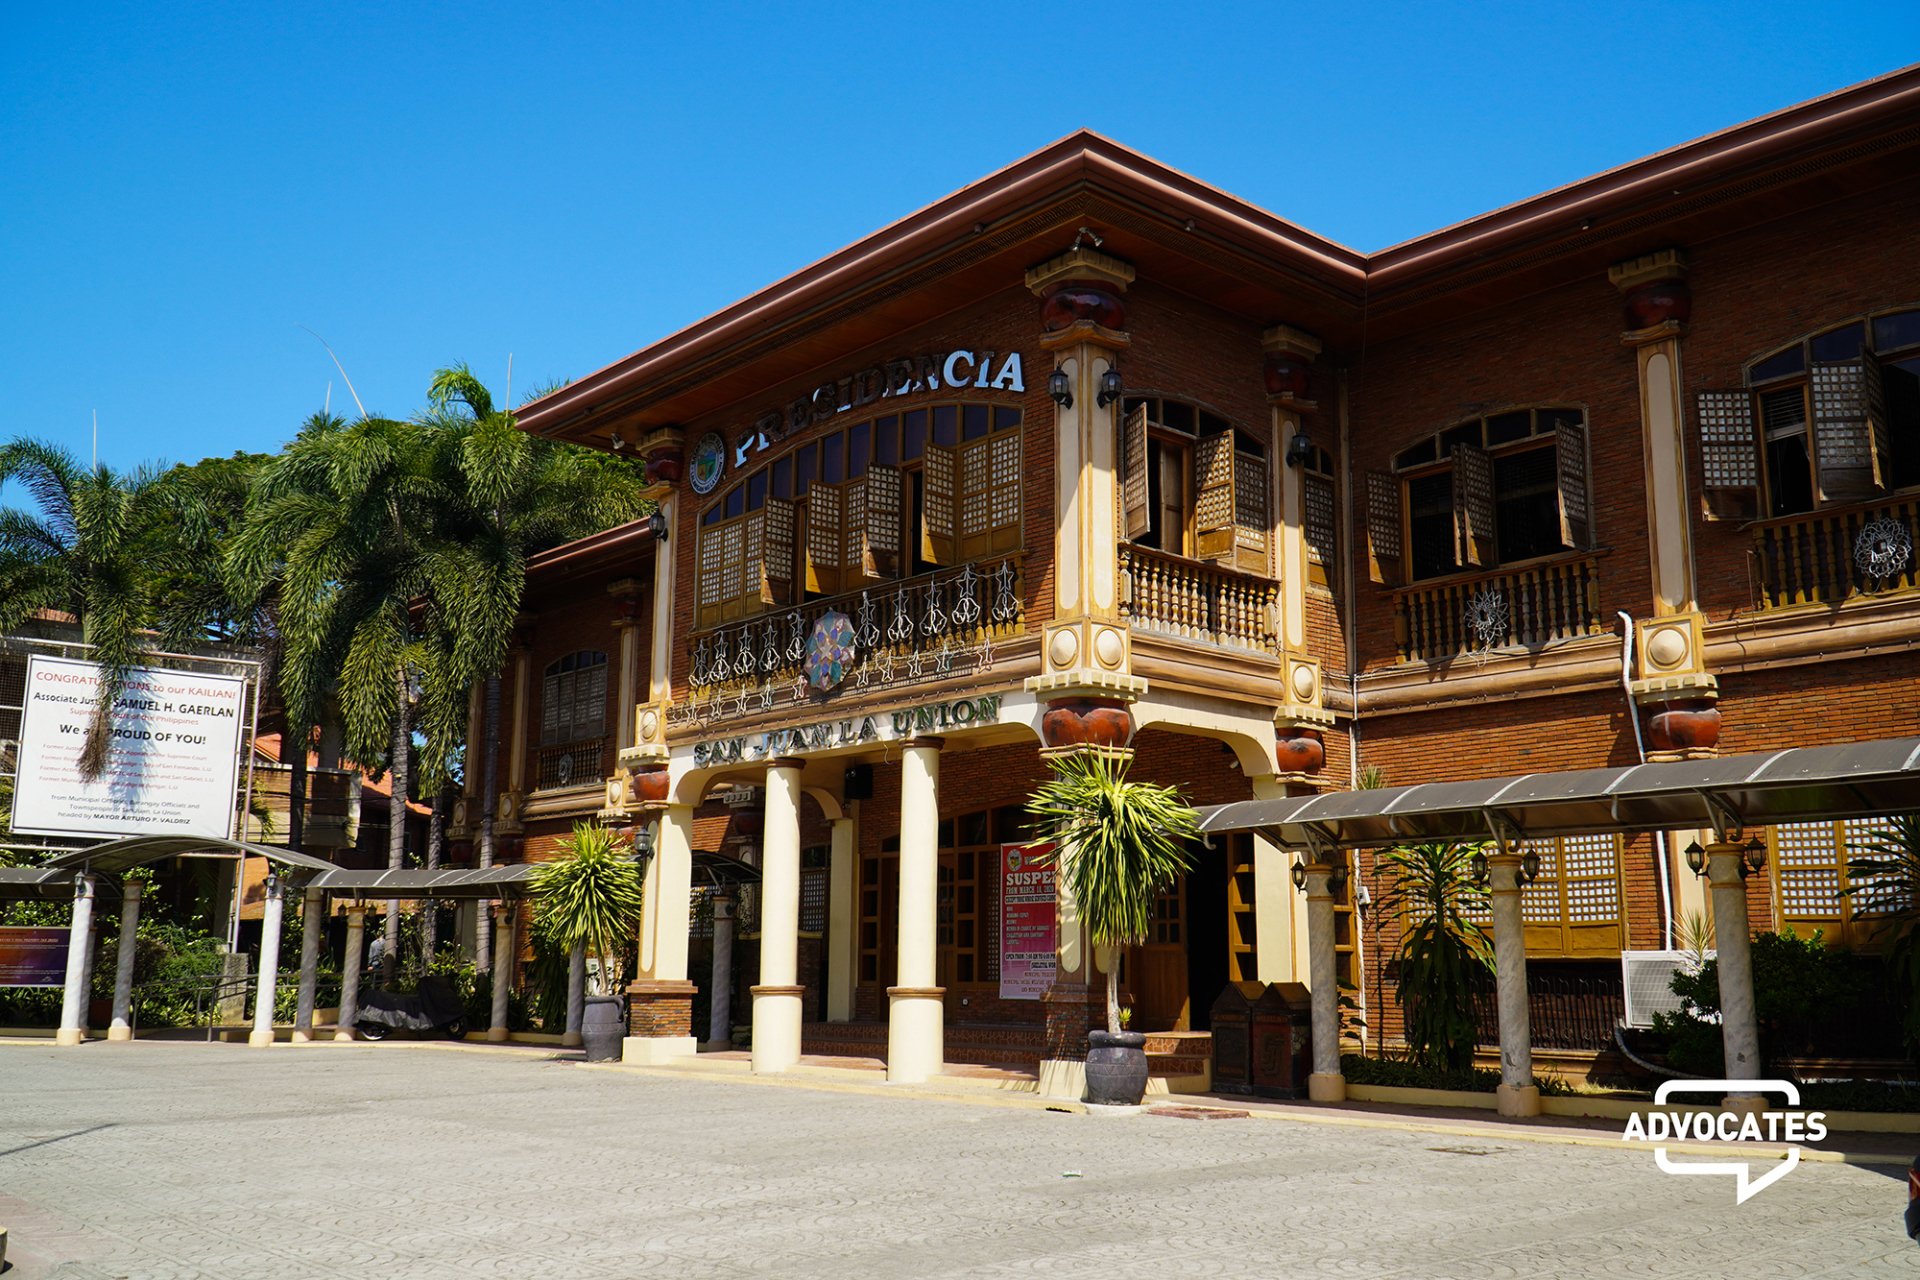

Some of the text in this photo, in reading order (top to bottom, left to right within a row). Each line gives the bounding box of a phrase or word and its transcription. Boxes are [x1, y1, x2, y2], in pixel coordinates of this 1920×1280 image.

[734, 349, 1026, 469] PRESIDENCIA
[36, 671, 150, 691] CONGRATUTIONS
[153, 684, 164, 692] to
[188, 687, 236, 699] KAILIAN!
[33, 692, 78, 704] Associate
[113, 698, 161, 711] SAMUEL
[163, 703, 176, 712] H.
[178, 703, 235, 718] GAERLAN
[59, 724, 80, 734] We
[154, 732, 172, 741] OF
[175, 734, 207, 745] YOU!
[694, 695, 1003, 769] SAN JUAN LA UNION
[93, 813, 120, 821] MAYOR
